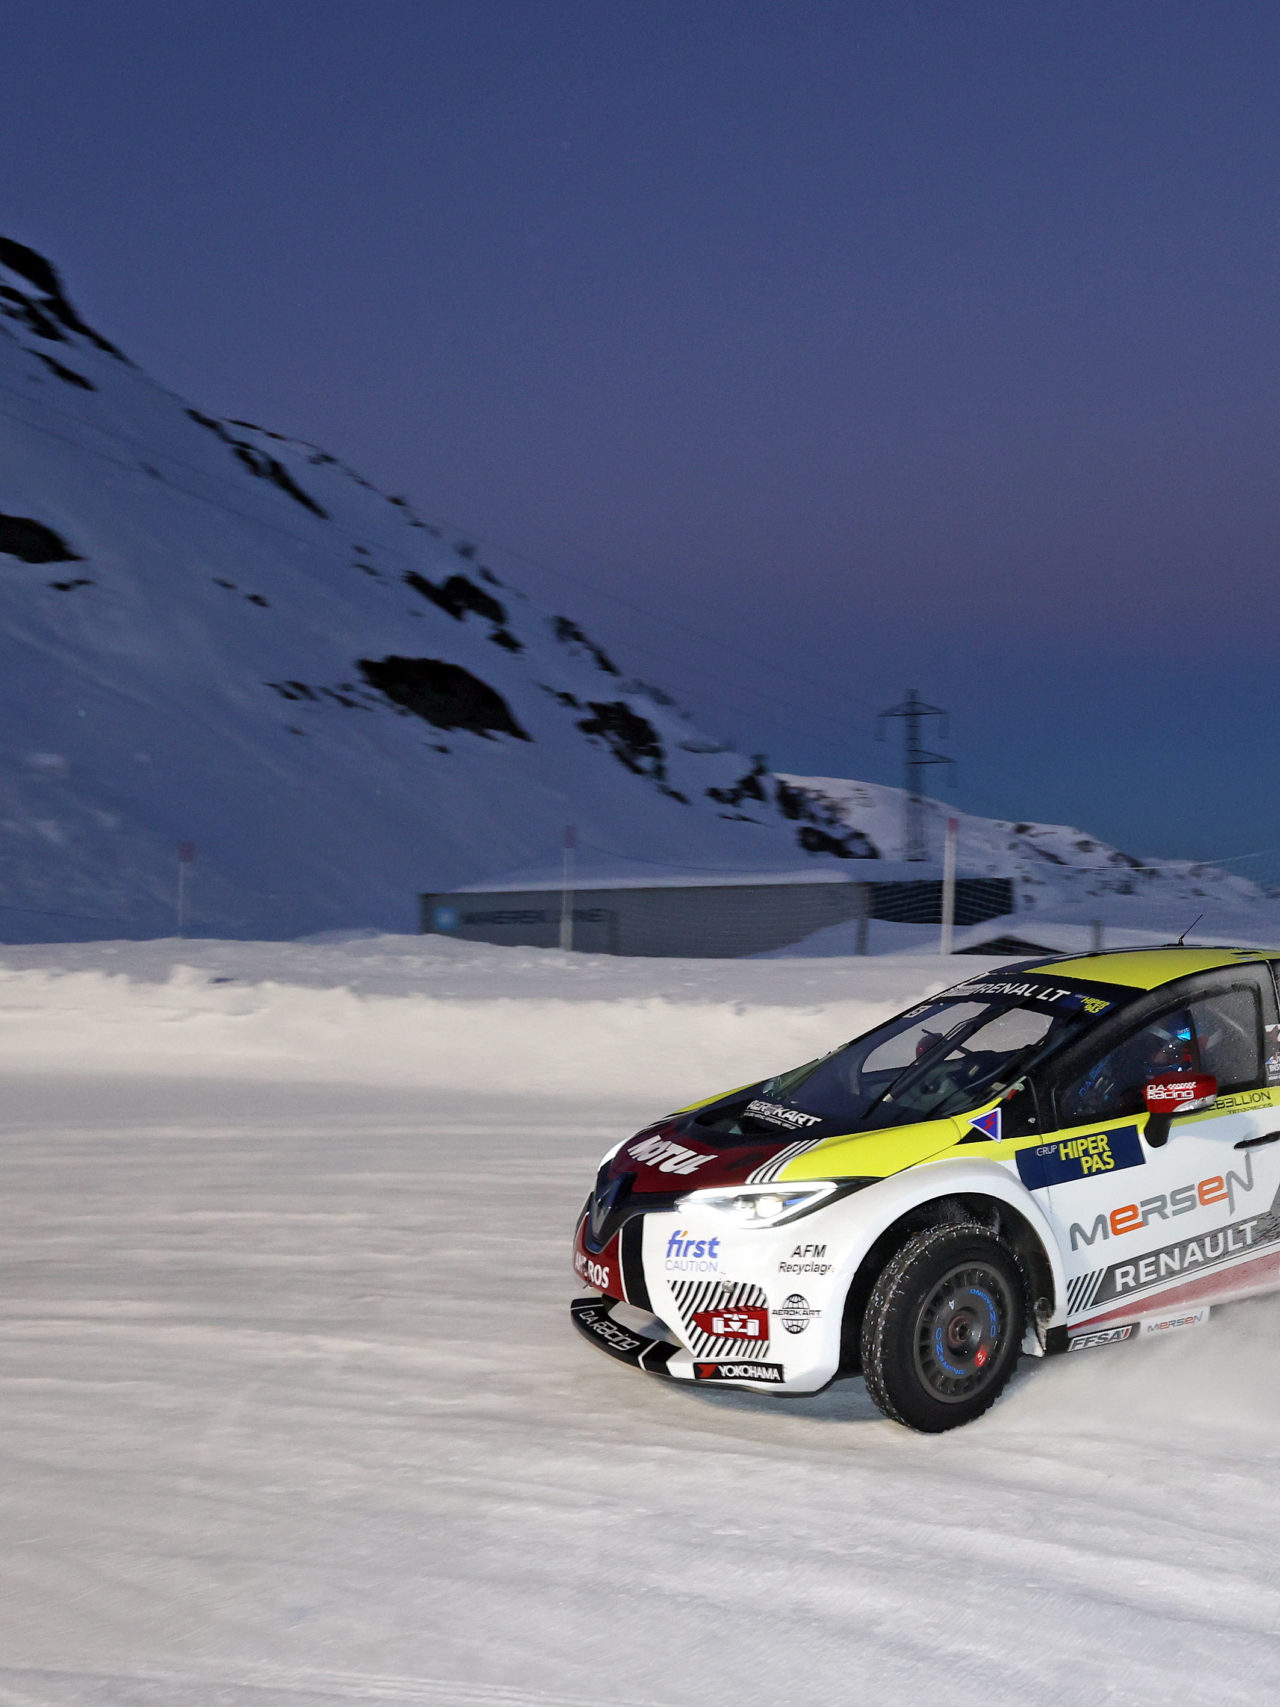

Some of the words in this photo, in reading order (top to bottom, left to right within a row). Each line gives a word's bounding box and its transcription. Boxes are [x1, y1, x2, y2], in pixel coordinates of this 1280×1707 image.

[1208, 1091, 1272, 1111] EBELLION
[627, 1134, 718, 1175] MOTUL
[1036, 1145, 1058, 1157] GRUP
[1059, 1134, 1111, 1160] HIPER
[1081, 1151, 1115, 1174] PAS
[666, 1230, 720, 1259] first
[790, 1244, 828, 1259] AFM
[664, 1260, 718, 1273] CAUTION
[1114, 1220, 1257, 1292] RENAULT
[1071, 1329, 1122, 1350] FFSA
[718, 1365, 781, 1382] YOKOHAMA
